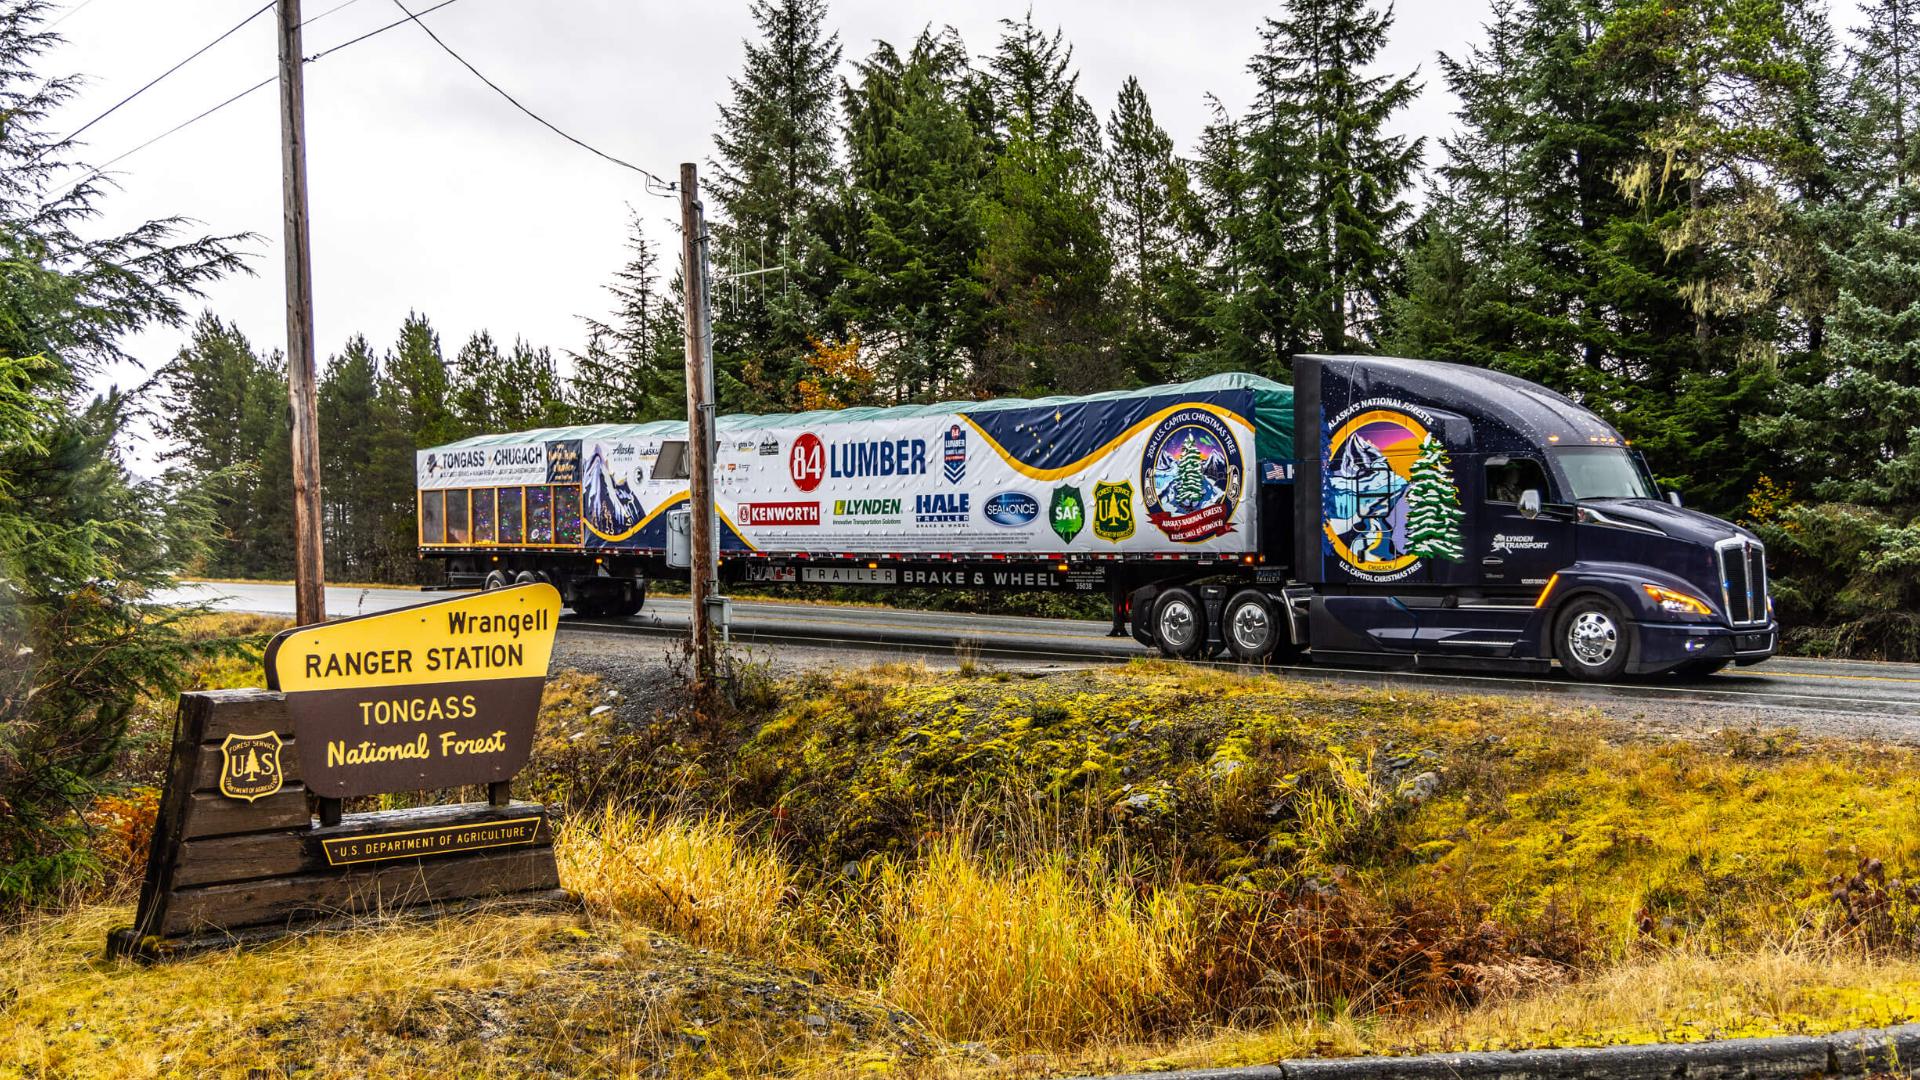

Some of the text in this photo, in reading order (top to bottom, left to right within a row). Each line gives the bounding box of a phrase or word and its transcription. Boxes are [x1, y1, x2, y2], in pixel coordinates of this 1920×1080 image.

[1327, 397, 1434, 430] ALASKA'S NATIONAL FORESTS
[1147, 441, 1158, 459] 2024
[1164, 412, 1191, 430] CAPITOL
[1191, 412, 1227, 437] CHRISTMAS
[1225, 434, 1237, 456] TREE
[442, 450, 485, 470] TONGASS
[495, 446, 542, 466] CHUGACH
[612, 442, 635, 456] Alaska
[793, 438, 926, 480] 84 LUMBER
[751, 506, 818, 521] KENWORTH
[846, 498, 901, 515] LYNDEN
[916, 493, 970, 514] HALE
[1056, 506, 1080, 520] SAF
[1203, 506, 1223, 518] FORESTS
[853, 518, 882, 526] Transportation
[806, 568, 893, 581] TRAILER
[904, 570, 966, 584] BRAKE
[974, 572, 984, 584] &
[994, 572, 1060, 586] WHEEL
[1350, 568, 1374, 582] CAPITOL
[1373, 570, 1408, 582] CHRISTMAS
[1406, 560, 1422, 574] TREE
[448, 608, 548, 638] Wrangell
[306, 644, 523, 678] RANGER STATION
[359, 695, 477, 726] TONGASS
[229, 740, 275, 754] FOREST SERVICE
[327, 730, 507, 768] National Forest
[340, 826, 526, 857] U.S. DEPARTMENT OF AGRICULTURE
